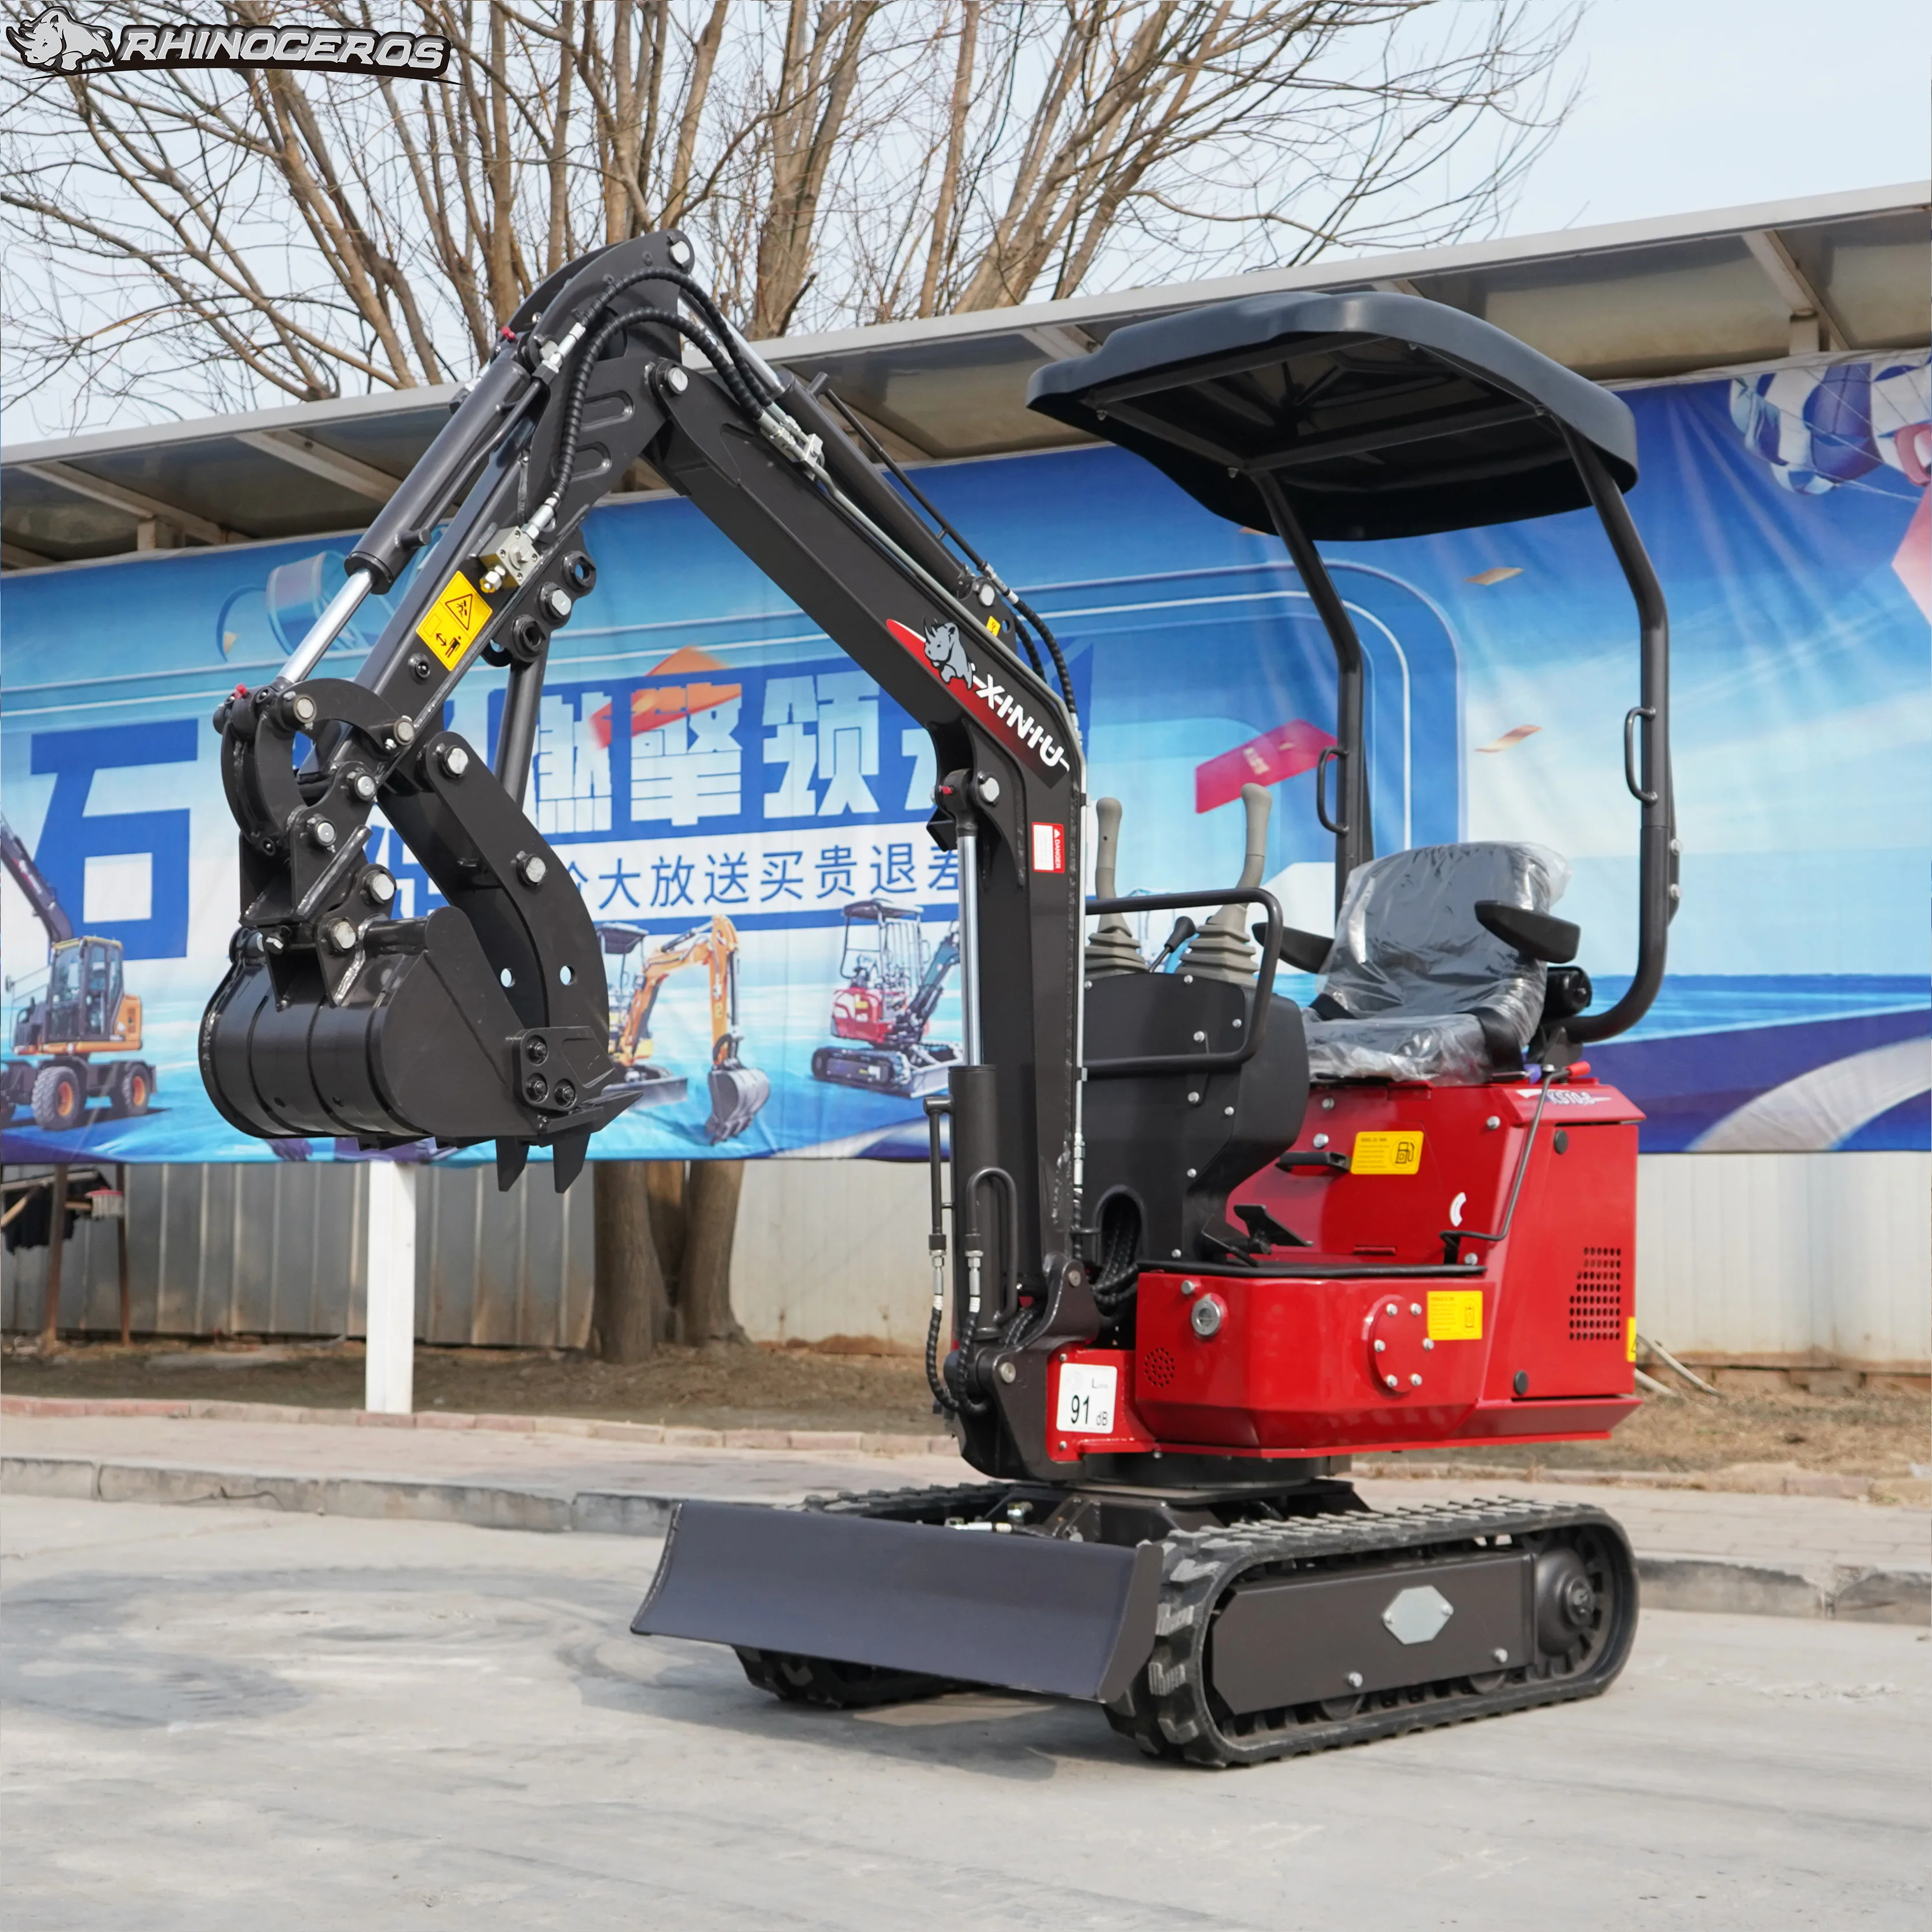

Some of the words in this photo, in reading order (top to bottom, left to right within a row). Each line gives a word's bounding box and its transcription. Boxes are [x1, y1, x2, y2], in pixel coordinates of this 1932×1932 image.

[31, 718, 198, 960] 石
[1071, 1395, 1090, 1425] 91
[1096, 1411, 1108, 1426] dB
